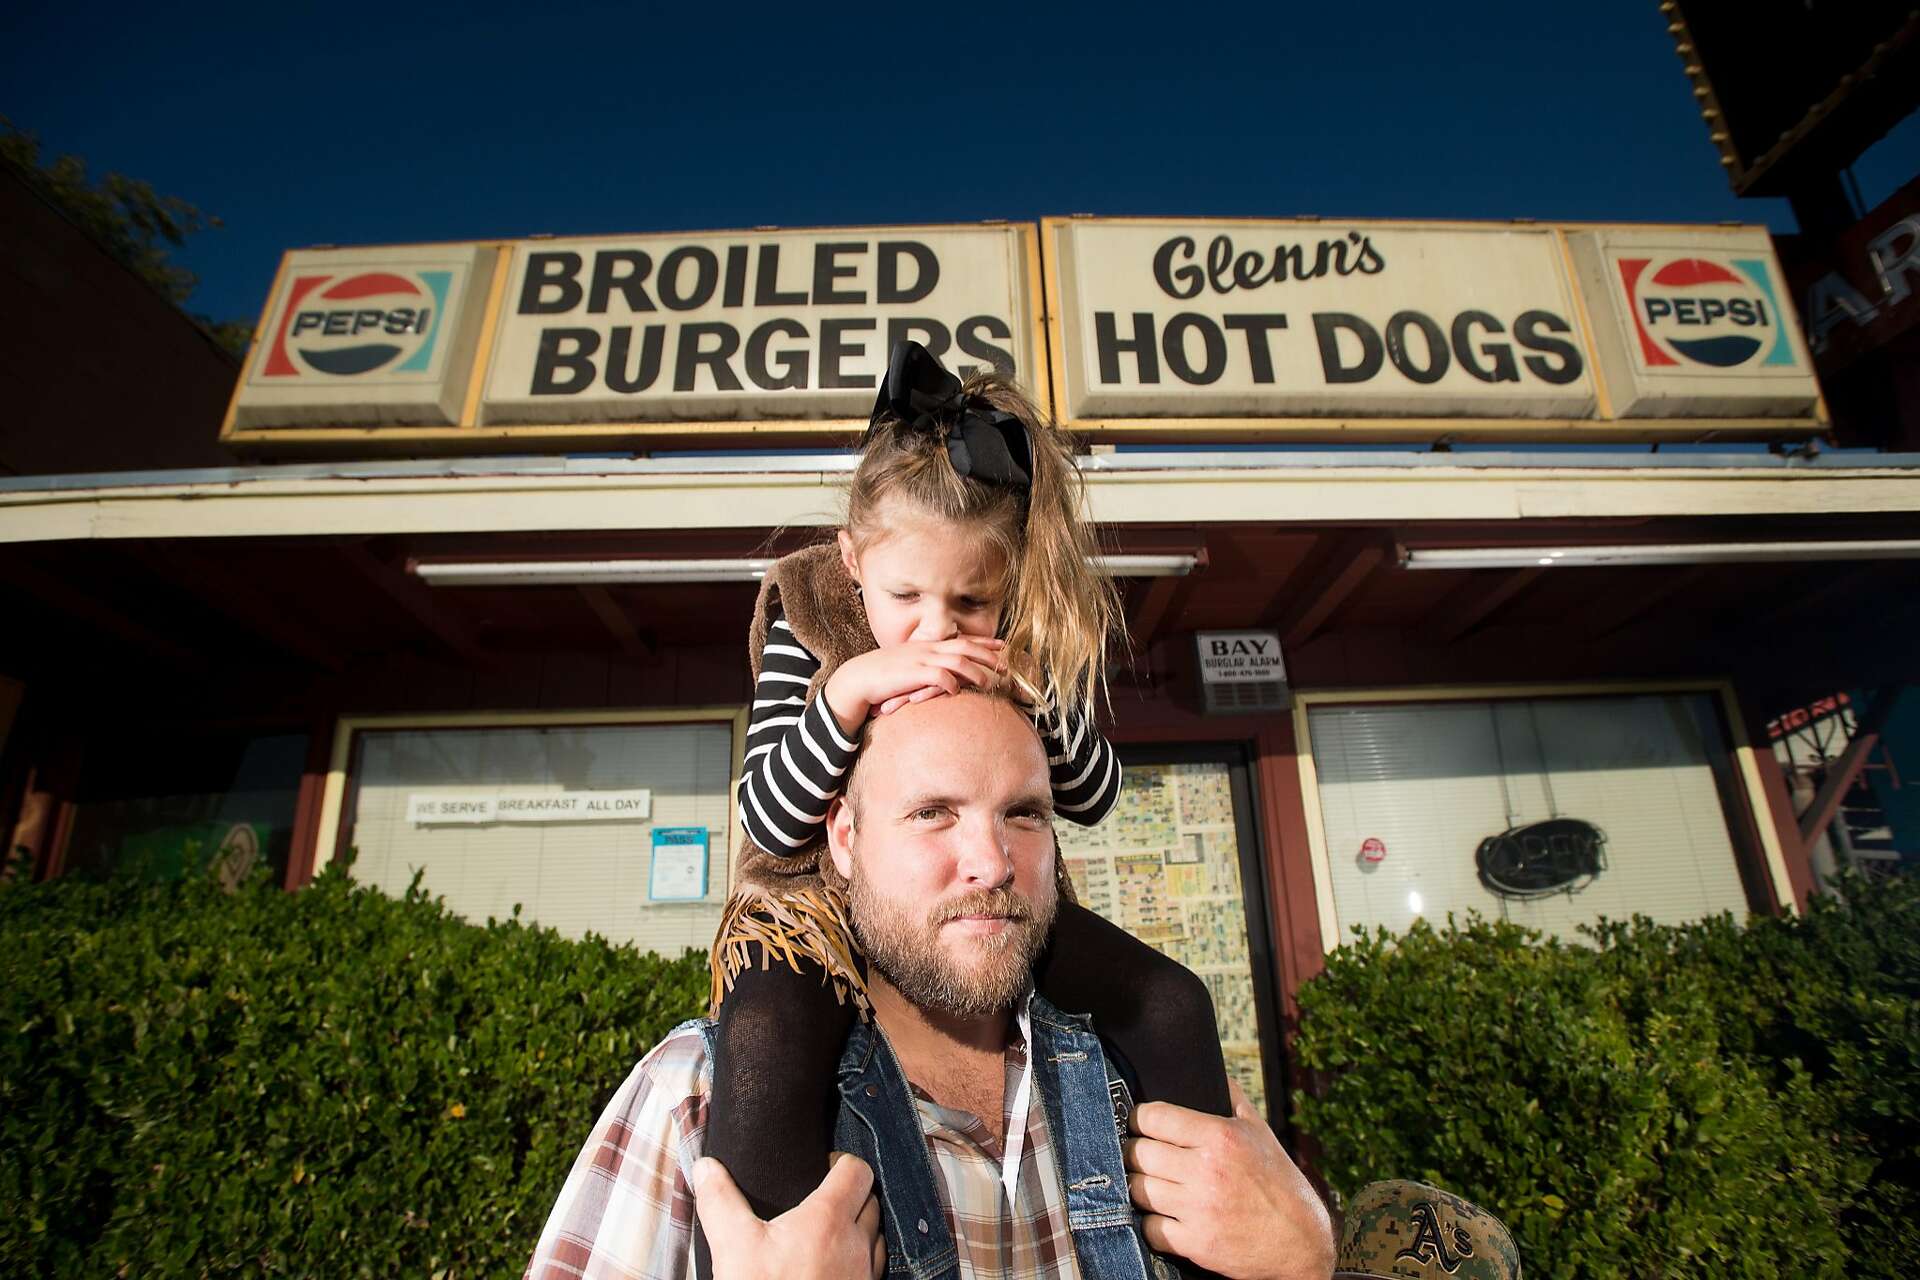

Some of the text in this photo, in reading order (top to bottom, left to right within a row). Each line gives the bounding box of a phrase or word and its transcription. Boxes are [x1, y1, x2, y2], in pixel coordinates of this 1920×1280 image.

[517, 241, 940, 315] BROILED
[1153, 231, 1385, 300] Glenn's
[292, 307, 430, 337] PEPSI
[1643, 297, 1769, 327] PEPSI
[1094, 309, 1583, 385] HOT DOGS
[1205, 656, 1279, 668] BURGLAR ALARM
[1210, 639, 1269, 656] BAY
[440, 800, 488, 814] SERVE
[498, 798, 577, 811] BREAKFAST
[586, 800, 611, 811] ALL
[614, 799, 641, 810] DAY
[1396, 1202, 1474, 1274] A's
